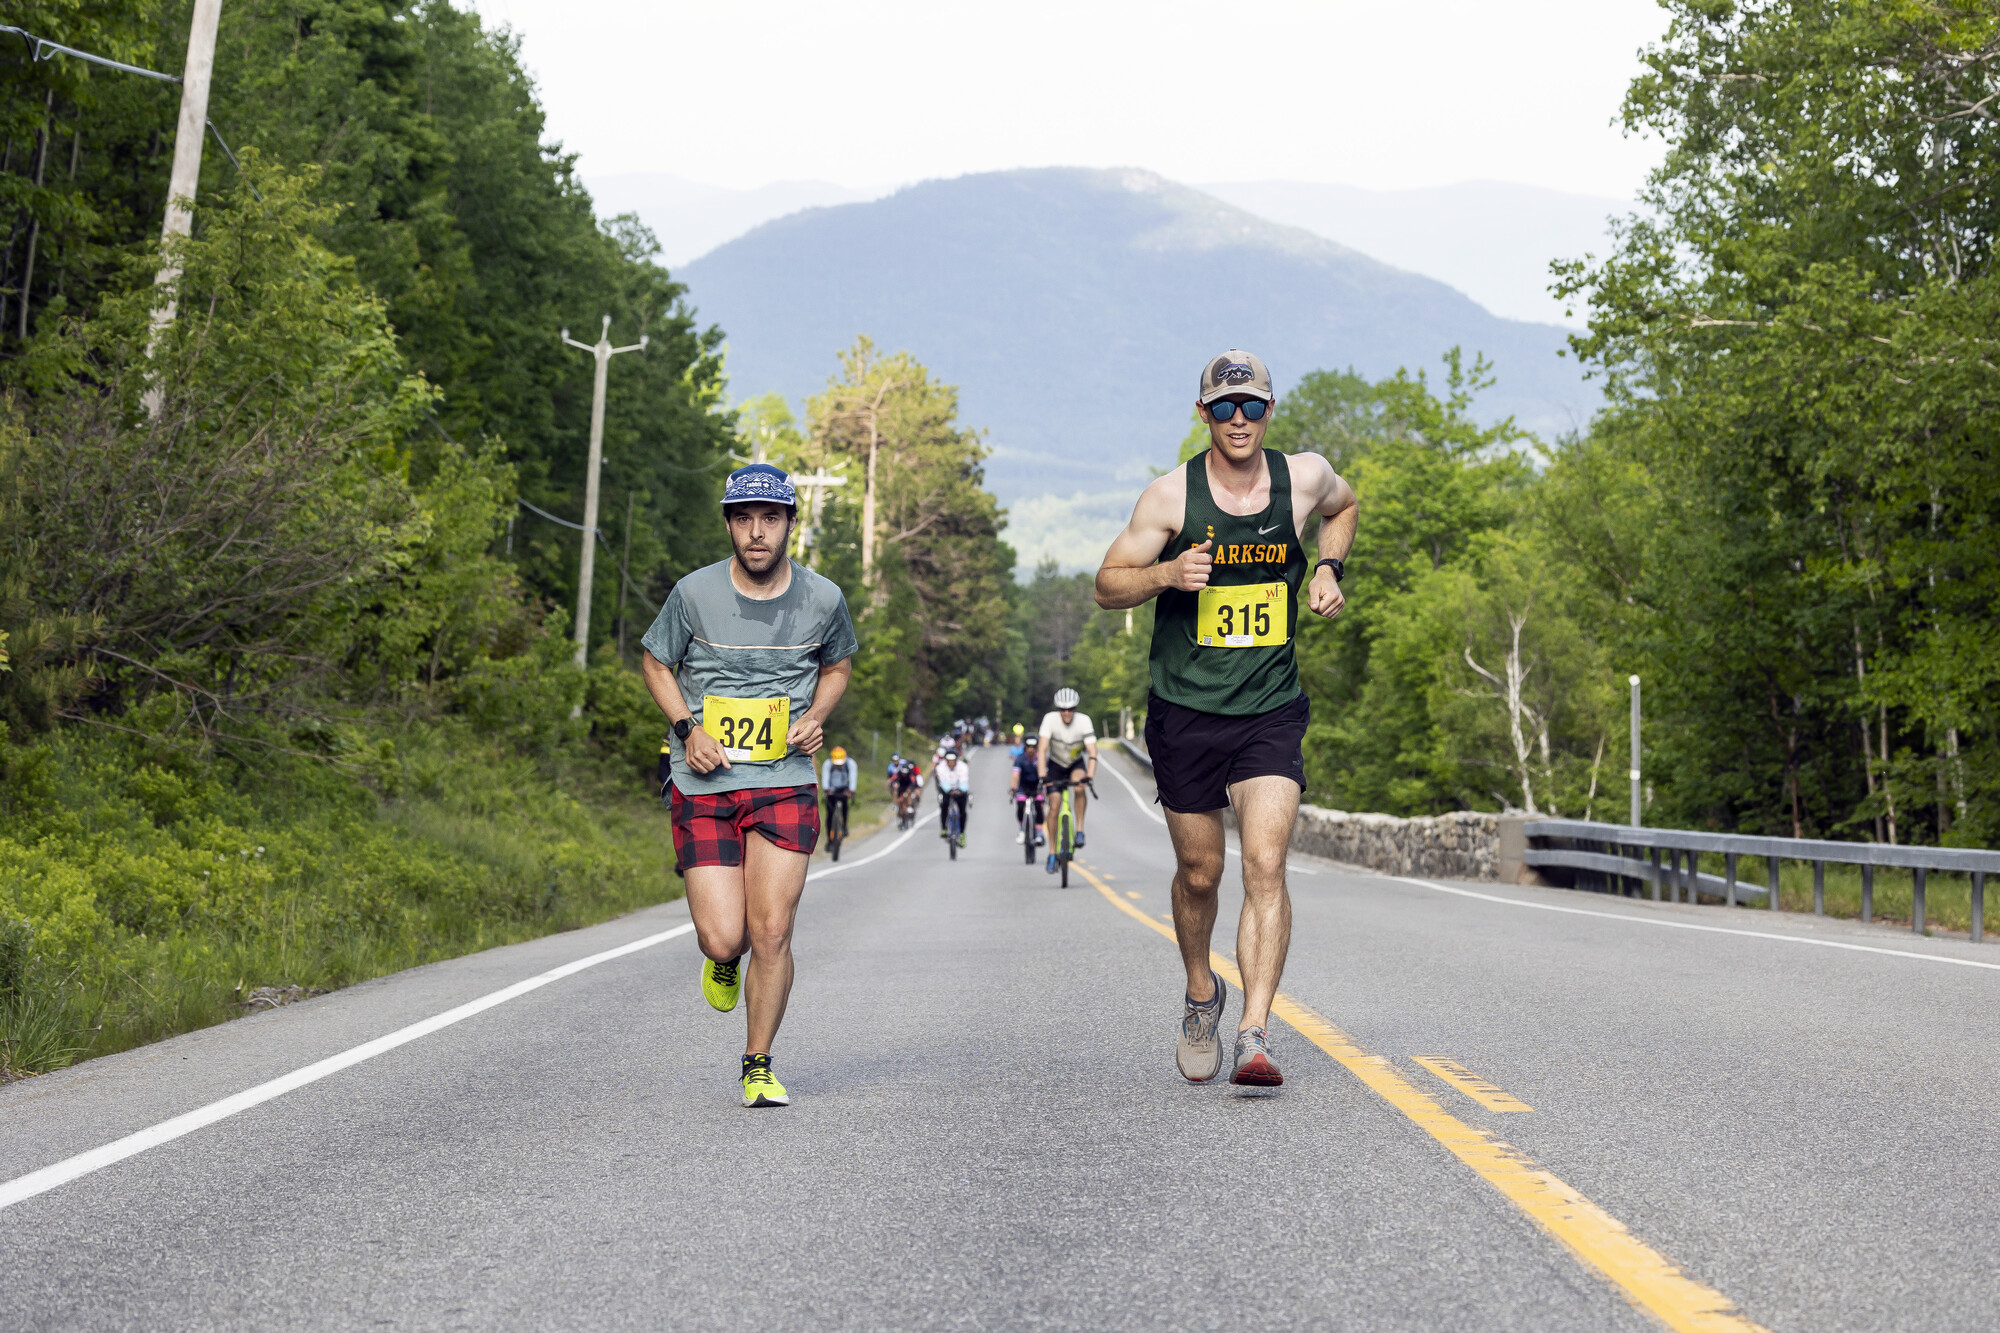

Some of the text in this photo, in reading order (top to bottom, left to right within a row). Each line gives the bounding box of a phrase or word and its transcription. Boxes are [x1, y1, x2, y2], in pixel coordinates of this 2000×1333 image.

[1191, 543, 1287, 564] ARKSON
[1217, 603, 1270, 638] 315
[720, 716, 773, 751] 324
